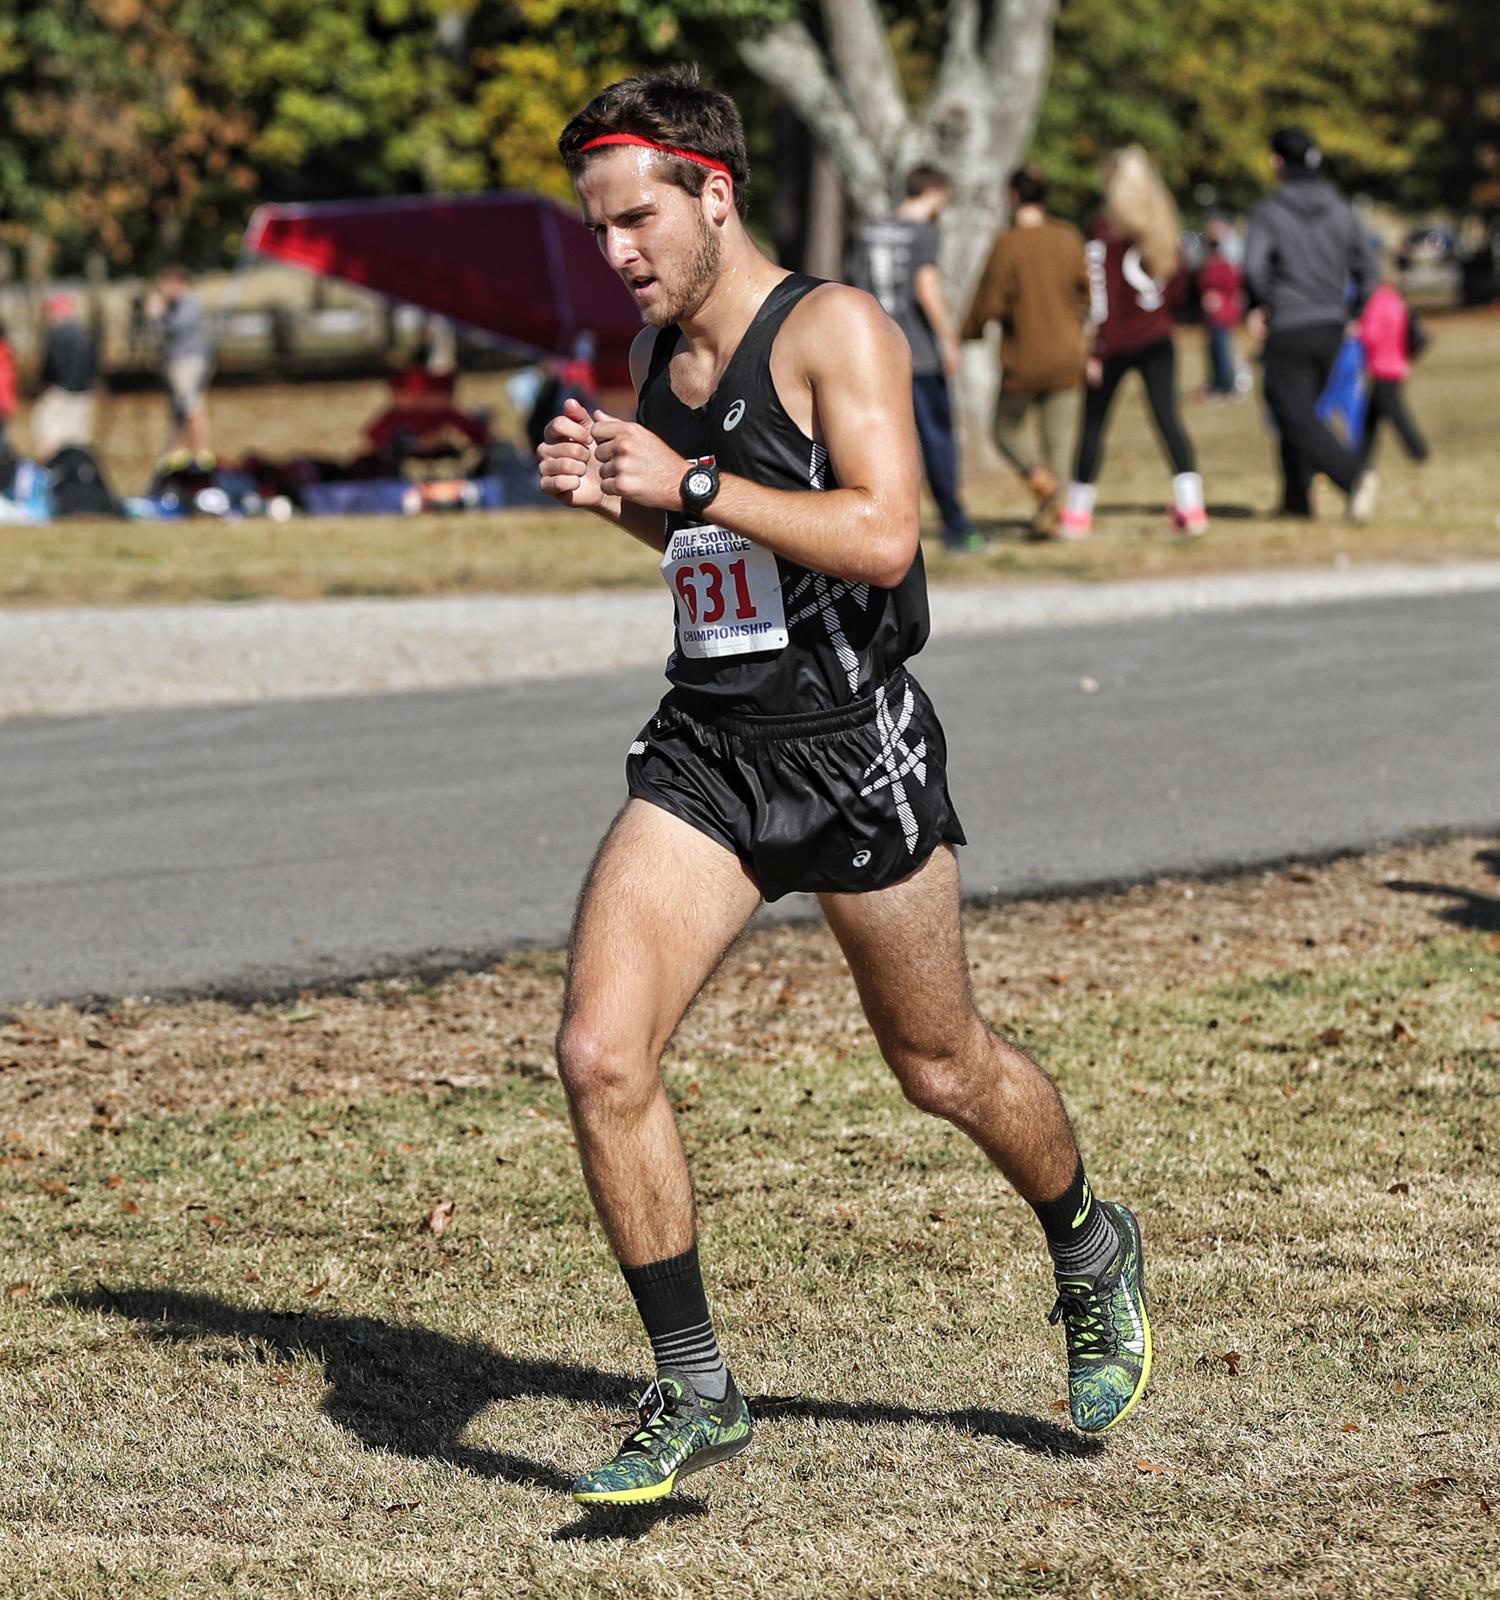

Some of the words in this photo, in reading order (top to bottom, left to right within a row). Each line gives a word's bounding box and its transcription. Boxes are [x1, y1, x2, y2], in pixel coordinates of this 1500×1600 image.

[671, 540, 750, 560] CONFERENCE
[674, 534, 696, 548] GULF
[675, 559, 757, 624] 631
[684, 622, 772, 642] CHAMPIONSHIP
